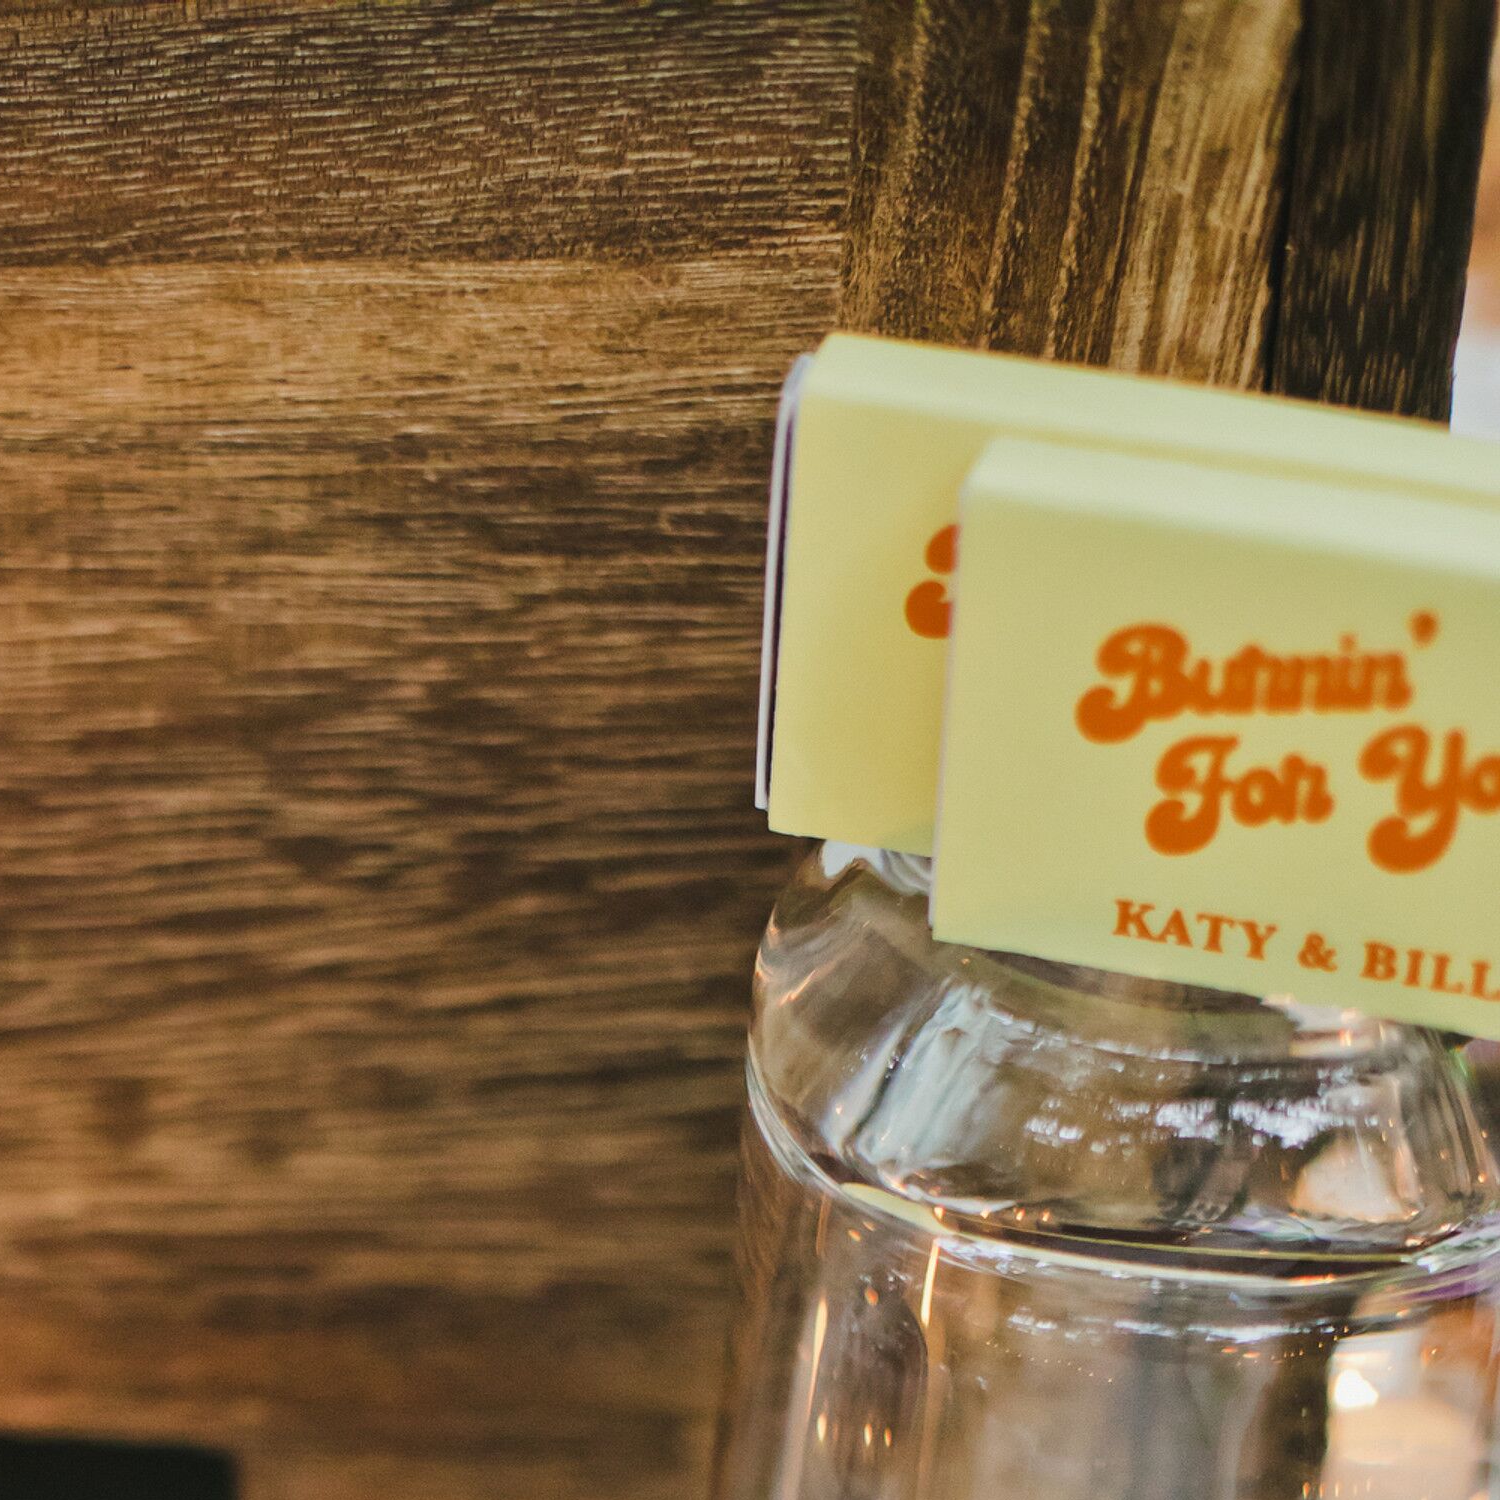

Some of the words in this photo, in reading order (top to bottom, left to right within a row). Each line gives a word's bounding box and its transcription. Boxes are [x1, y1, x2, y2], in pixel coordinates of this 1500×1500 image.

[1074, 611, 1440, 746] Burnin'
[1144, 734, 1337, 858] For
[1113, 898, 1279, 962] KATY
[1297, 932, 1338, 973] &
[1360, 940, 1500, 1003] BILL
